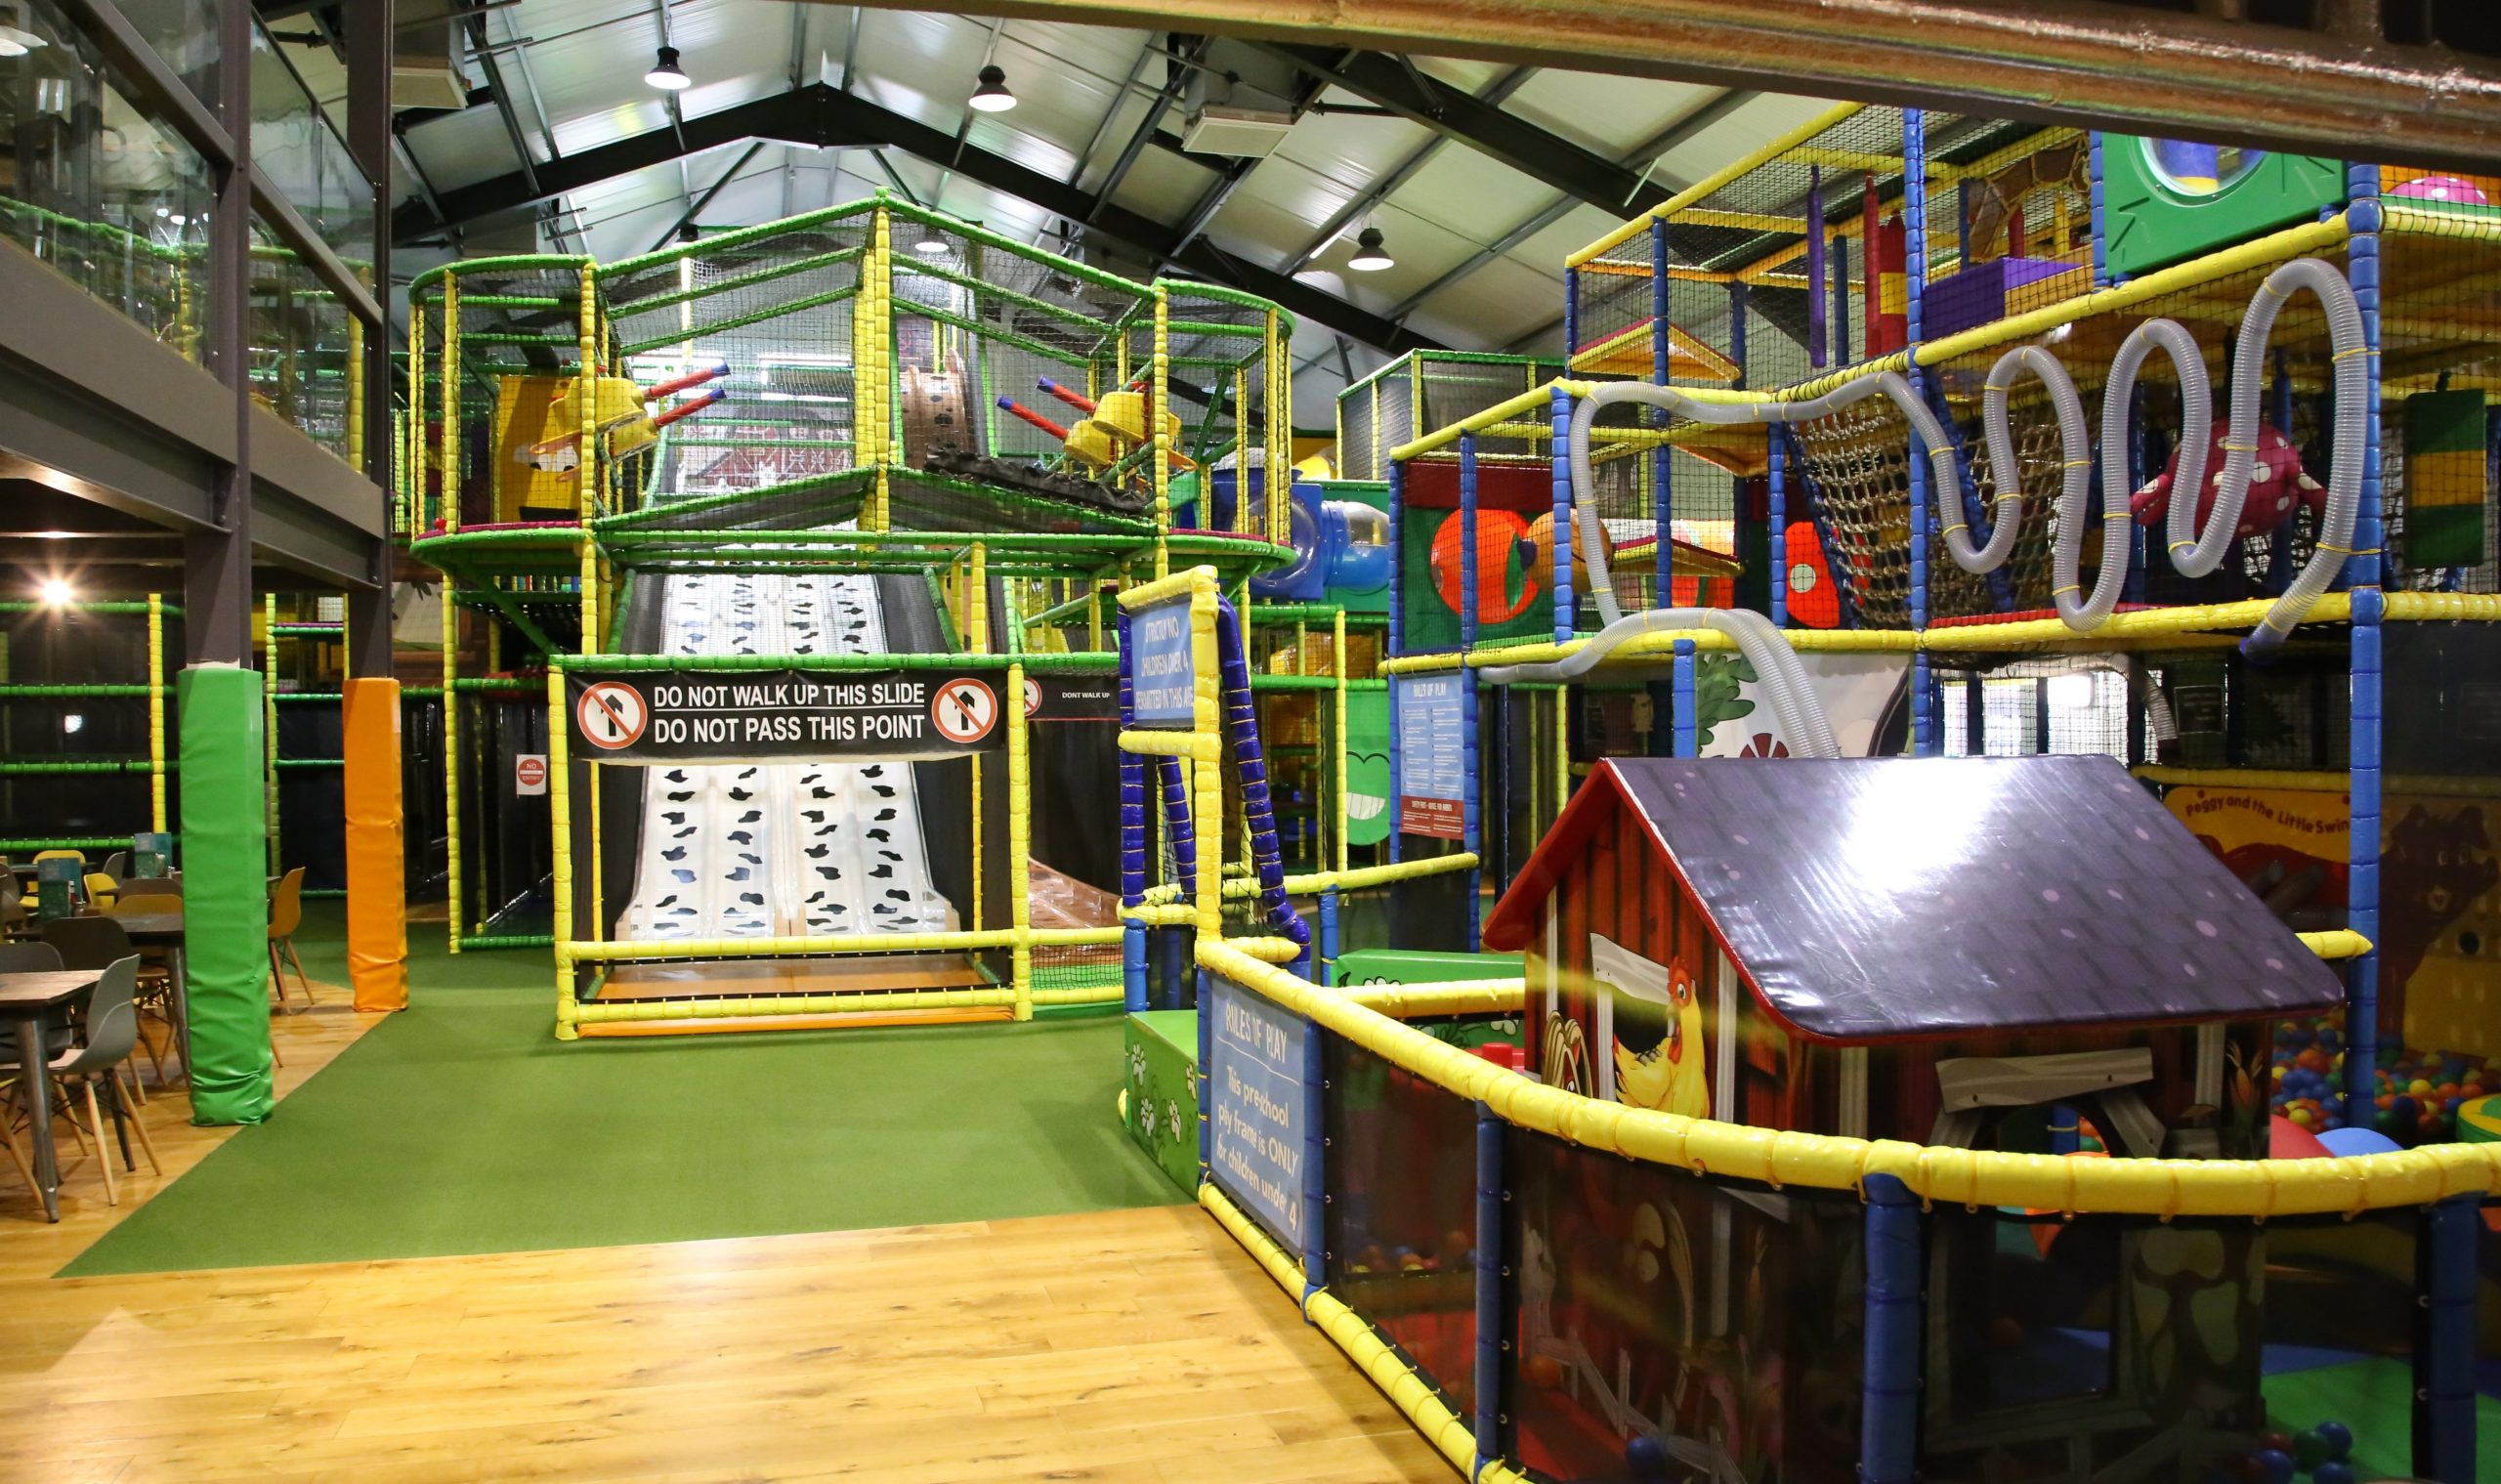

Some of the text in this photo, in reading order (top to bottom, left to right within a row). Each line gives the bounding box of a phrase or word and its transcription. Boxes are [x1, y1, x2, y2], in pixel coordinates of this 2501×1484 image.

[1145, 615, 1179, 643] STRICTLY NO
[1141, 654, 1167, 677] CHILDREN
[1168, 652, 1182, 674] OVER
[654, 683, 925, 707] DO NOT WALK UP THIS SLIDE
[1169, 687, 1182, 709] THIS
[1184, 685, 1194, 708] ARE
[655, 714, 925, 743] DO NOT PASS THIS POINT
[2185, 795, 2350, 833] Peggy and the Little Swin
[1225, 1002, 1288, 1063] RULES OF PLAY
[1227, 1065, 1242, 1096] This
[1218, 1099, 1298, 1177] play frame is ONLY
[1217, 1133, 1298, 1231] for children under 4
